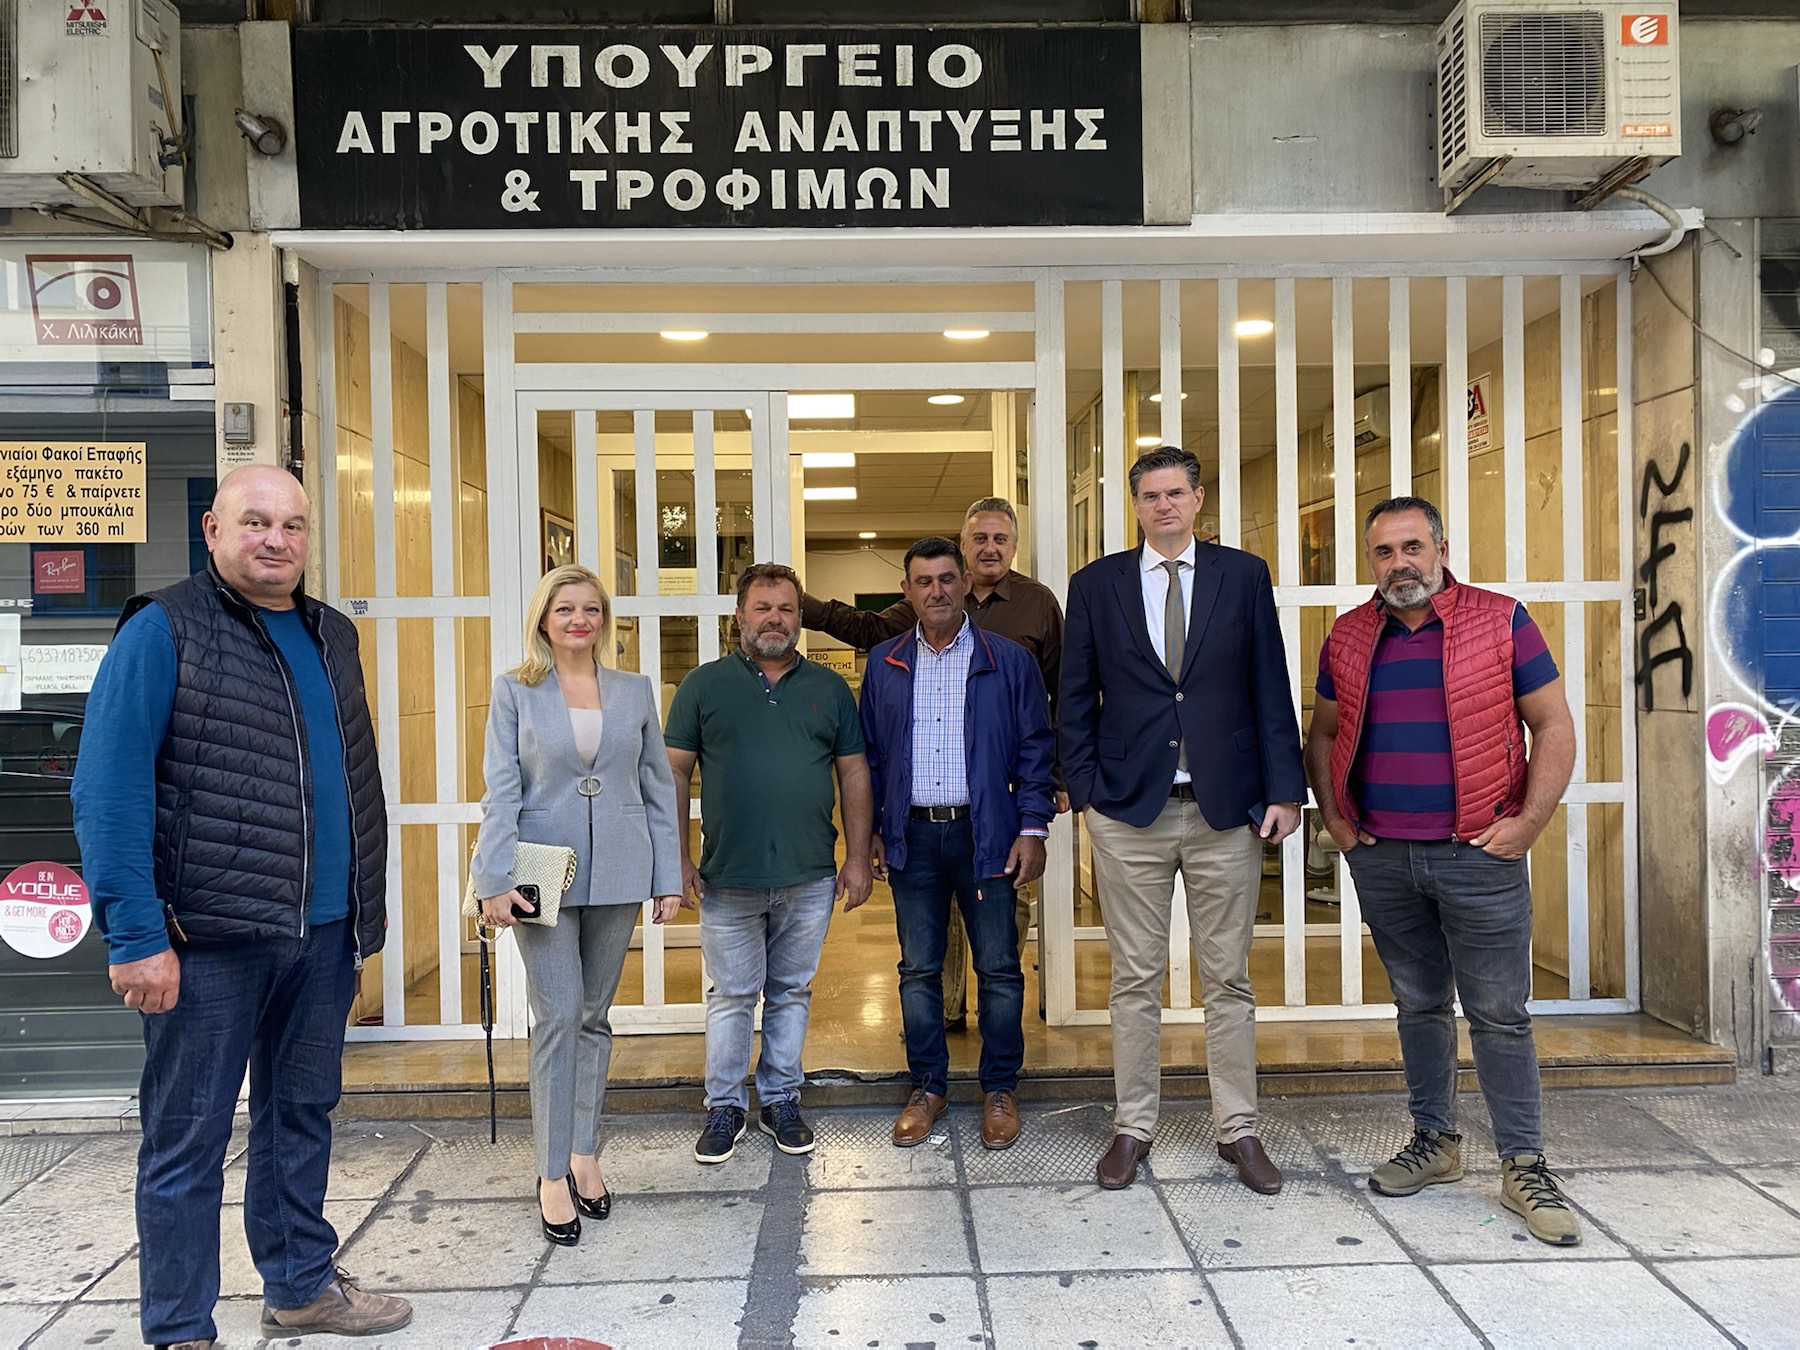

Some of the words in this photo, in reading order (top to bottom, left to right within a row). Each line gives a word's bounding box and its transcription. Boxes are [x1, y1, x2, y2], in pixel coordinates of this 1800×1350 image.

[463, 43, 983, 89] ΥΠΟΥΡΓΕΙΟ
[336, 111, 693, 155] ΑΓΡΟΤΙΚΗΣ
[734, 109, 1107, 152] ΑΝΑΠΤΥΞΗΣ
[501, 168, 541, 212] &
[569, 167, 950, 212] ΤΡΟΦΙΜΩΝ
[67, 323, 139, 343] Λιλικάκη
[0, 446, 37, 460] νιαίοι
[42, 446, 82, 461] Φακοί
[87, 446, 142, 464] Επαφής
[6, 465, 62, 482] εξάμηνο
[75, 465, 123, 480] πακέτο
[22, 484, 38, 498] 75
[45, 484, 54, 498] €
[66, 484, 76, 498] &
[81, 484, 141, 501] παίρνετε
[1, 506, 19, 520] ρο
[27, 502, 52, 517] δύο
[61, 502, 134, 520] μπουκάλια
[37, 525, 64, 536] των
[76, 522, 100, 536] 360
[108, 522, 124, 536] ml
[38, 871, 46, 881] BE
[47, 871, 54, 882] IN
[4, 905, 11, 917] &
[12, 905, 26, 917] GET
[26, 906, 48, 918] MORE
